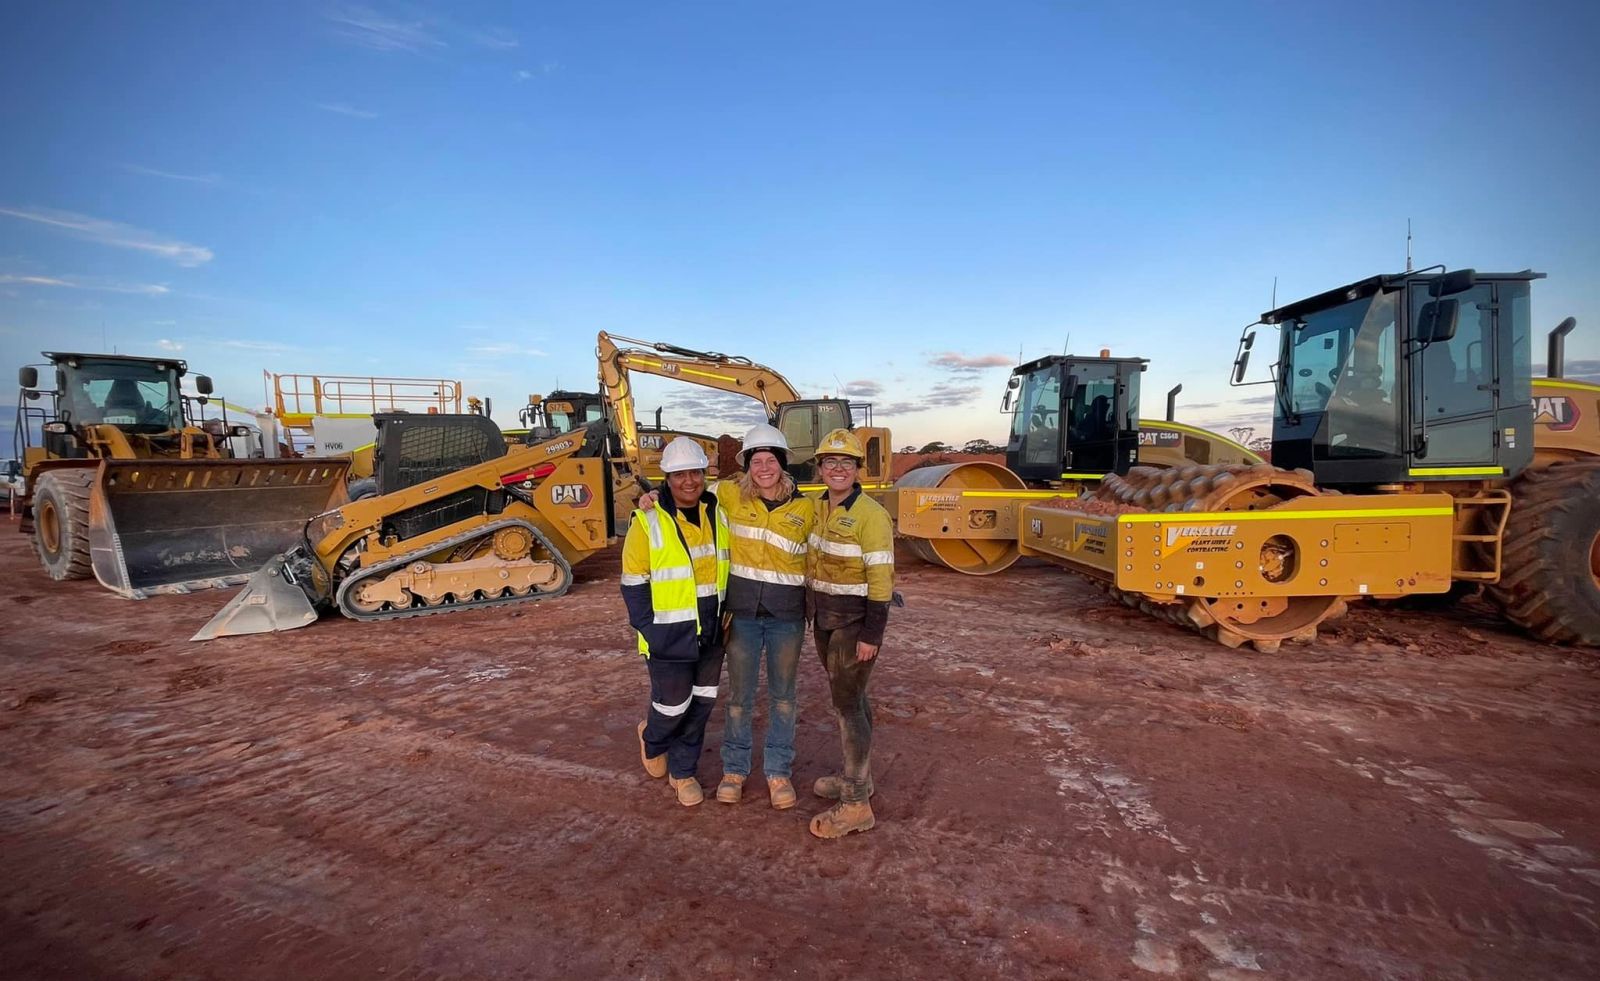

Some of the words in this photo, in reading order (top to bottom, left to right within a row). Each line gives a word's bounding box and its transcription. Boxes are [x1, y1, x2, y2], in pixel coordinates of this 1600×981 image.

[640, 435, 661, 449] CAT
[1138, 432, 1158, 446] CAT
[551, 485, 583, 504] CAT
[1166, 525, 1237, 547] VERSATILE
